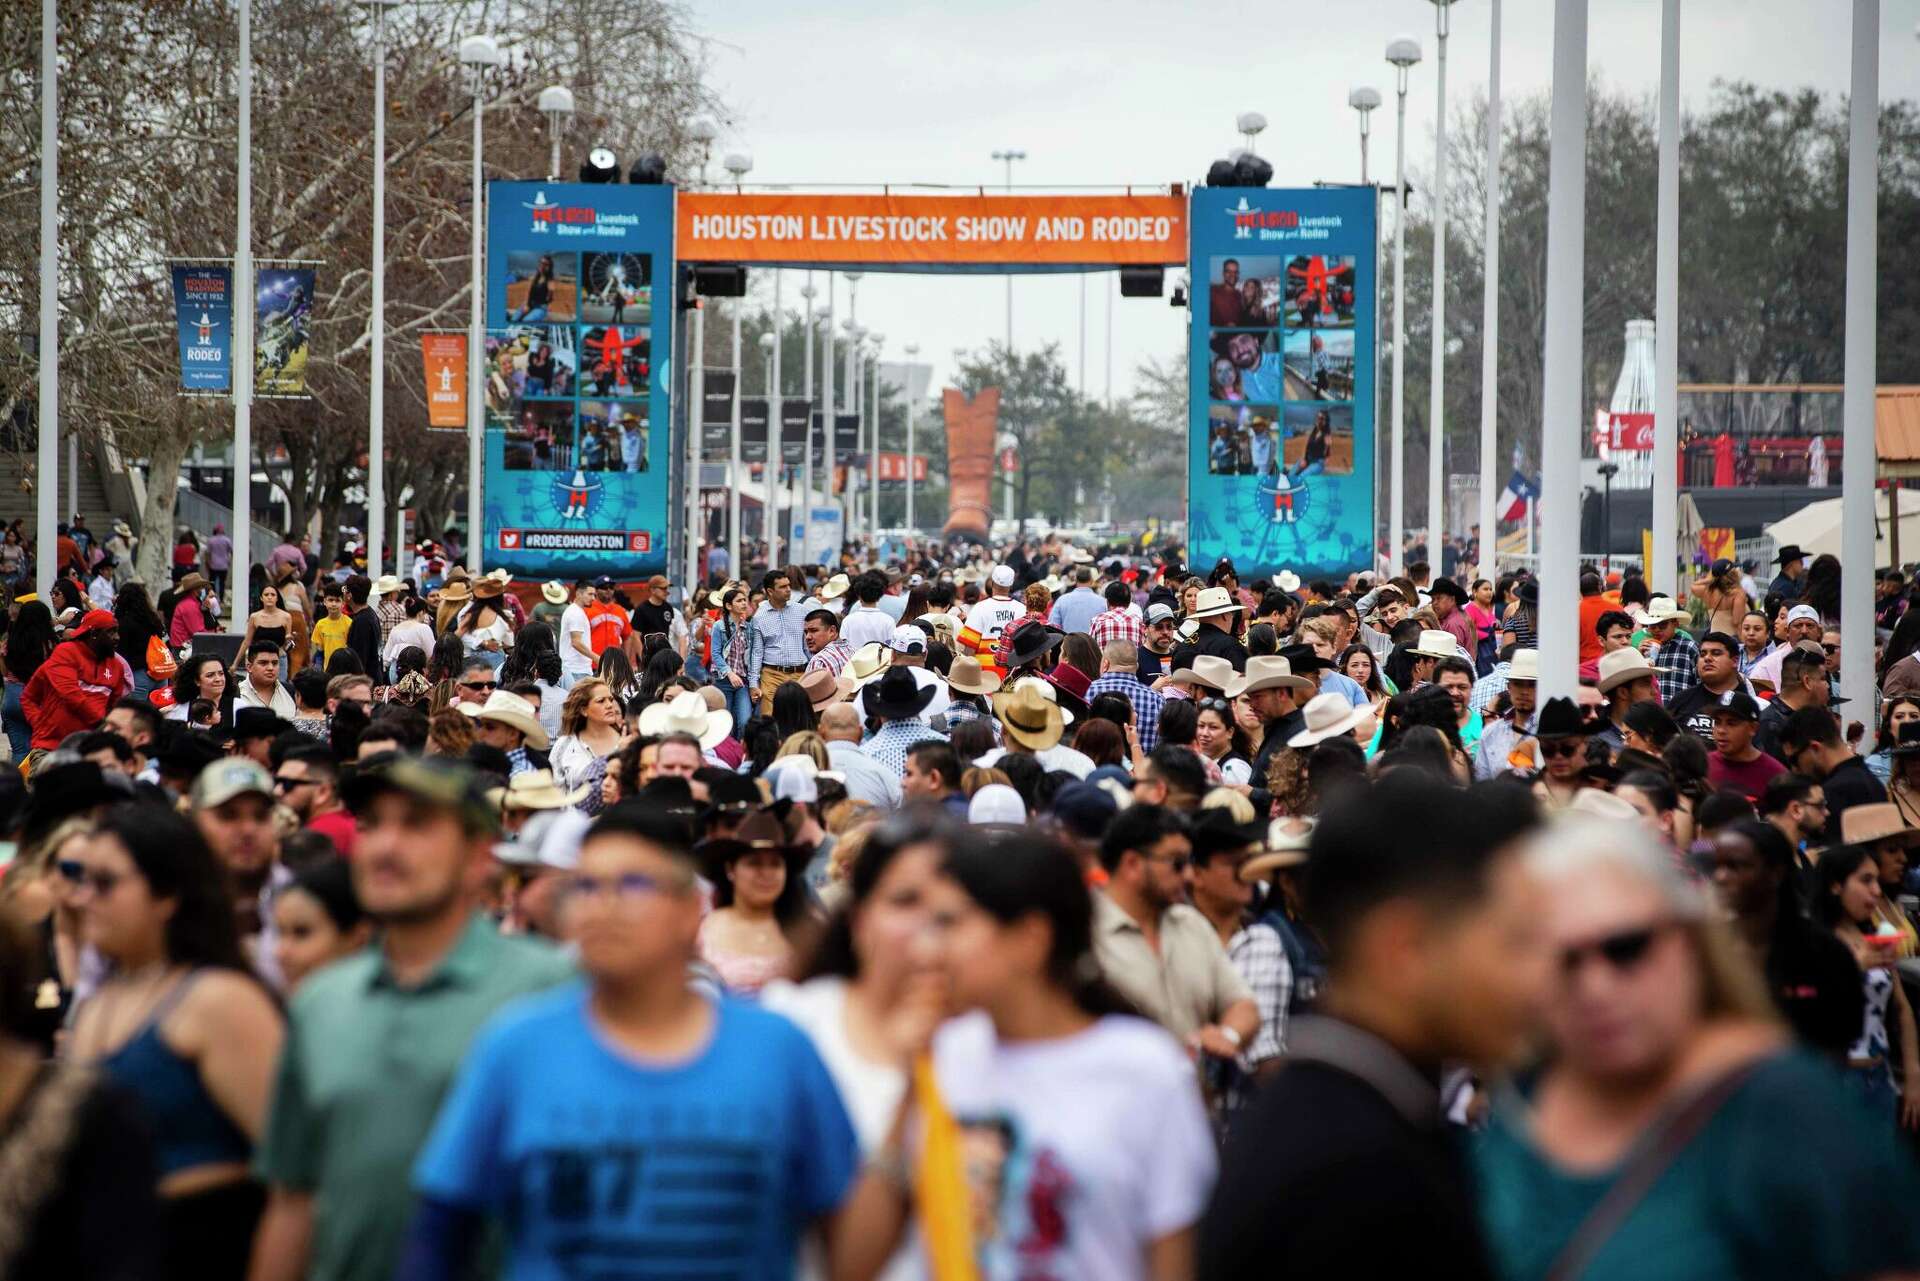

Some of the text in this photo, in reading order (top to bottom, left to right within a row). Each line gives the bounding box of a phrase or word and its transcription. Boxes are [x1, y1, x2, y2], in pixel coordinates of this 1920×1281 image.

[692, 214, 804, 240] HOUSTON
[810, 215, 948, 241] LIVESTOCK
[955, 216, 1027, 241] SHOW
[1034, 216, 1088, 241] AND
[1299, 215, 1342, 227] Livestock
[1260, 228, 1285, 240] Show
[1300, 227, 1329, 240] Rodeo
[185, 292, 208, 300] SINCE
[187, 348, 222, 361] RODEO
[525, 534, 624, 549] #RODEOHOUSTON
[995, 610, 1015, 621] RYAN
